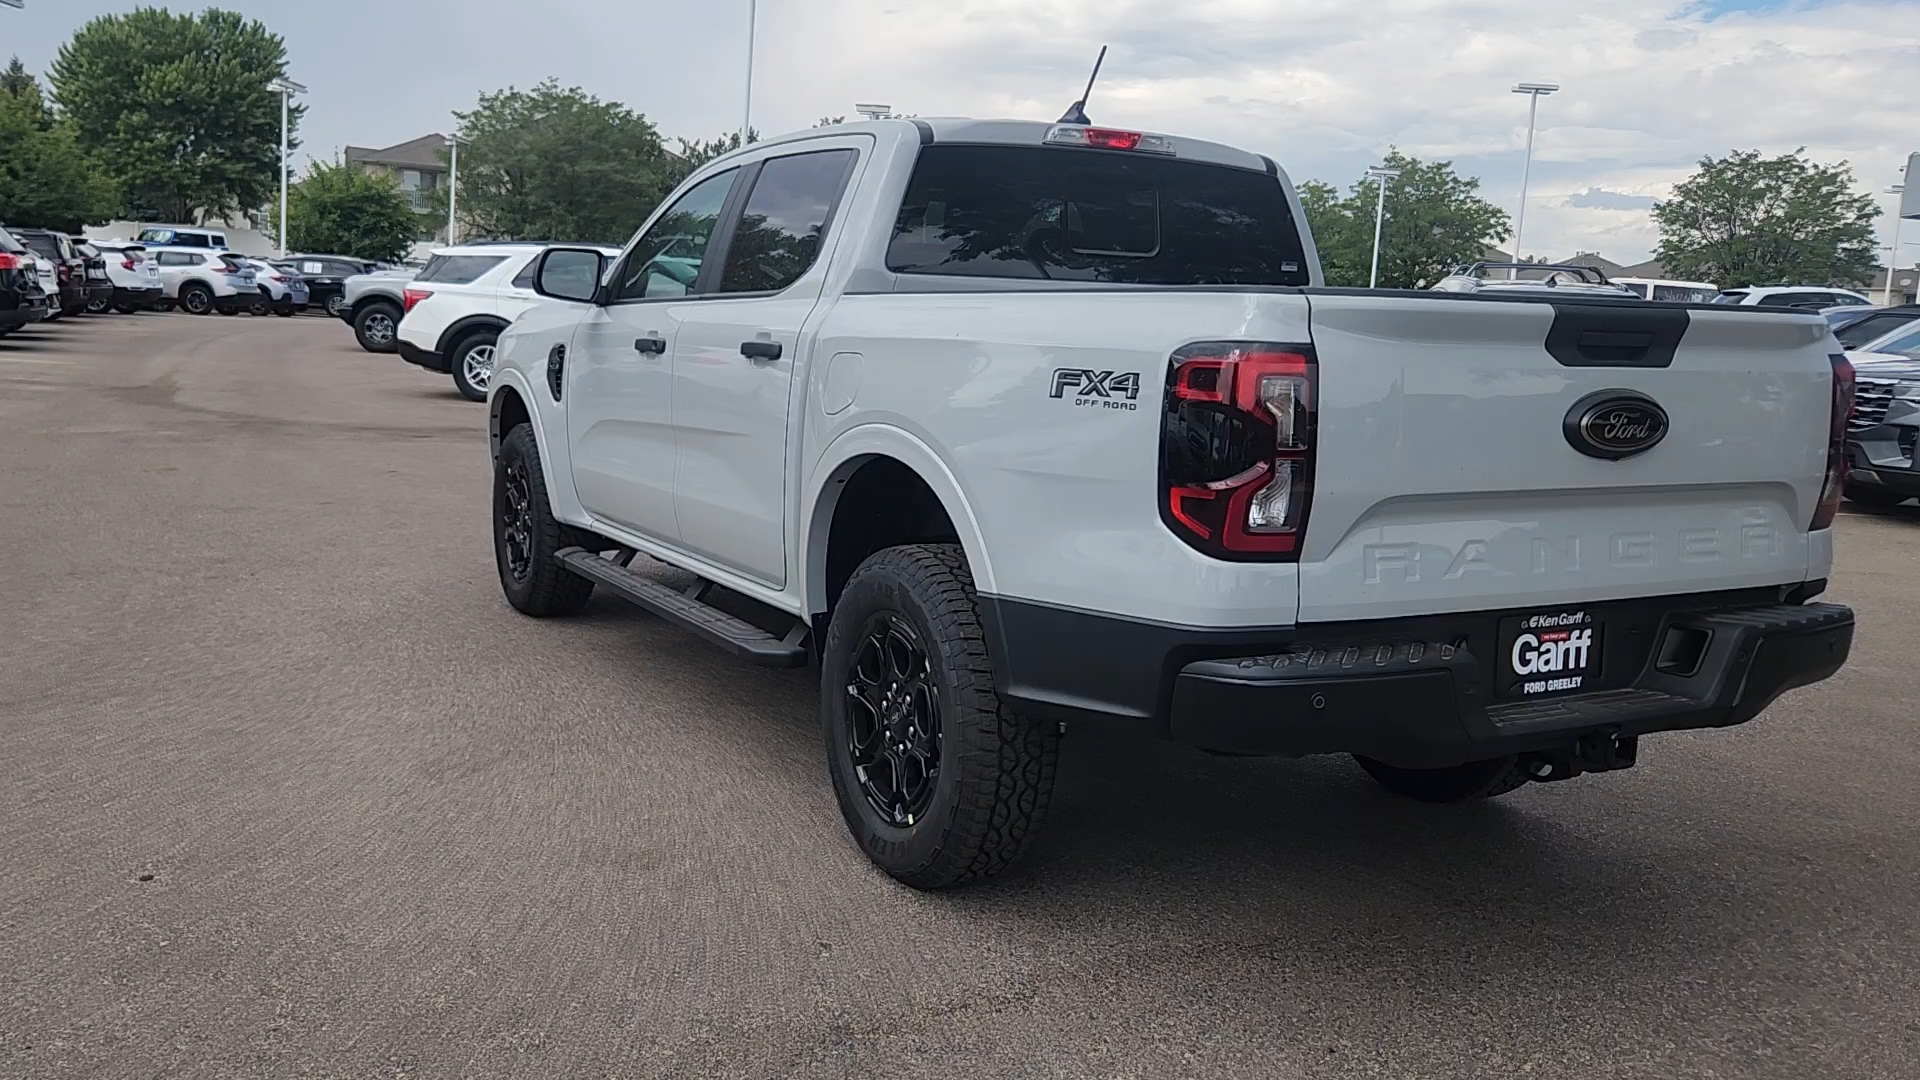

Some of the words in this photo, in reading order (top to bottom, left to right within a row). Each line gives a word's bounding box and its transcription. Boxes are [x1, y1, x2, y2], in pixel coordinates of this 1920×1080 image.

[1049, 368, 1141, 400] FX4
[1075, 398, 1099, 408] OFF
[1103, 401, 1138, 411] ROAD
[1604, 411, 1651, 439] Ford
[1362, 522, 1780, 585] RANGER
[1538, 614, 1559, 628] Ken
[1559, 611, 1585, 626] Garff
[1512, 629, 1592, 675] Garff
[1524, 681, 1546, 694] FORD
[1547, 677, 1583, 691] GREELEY
